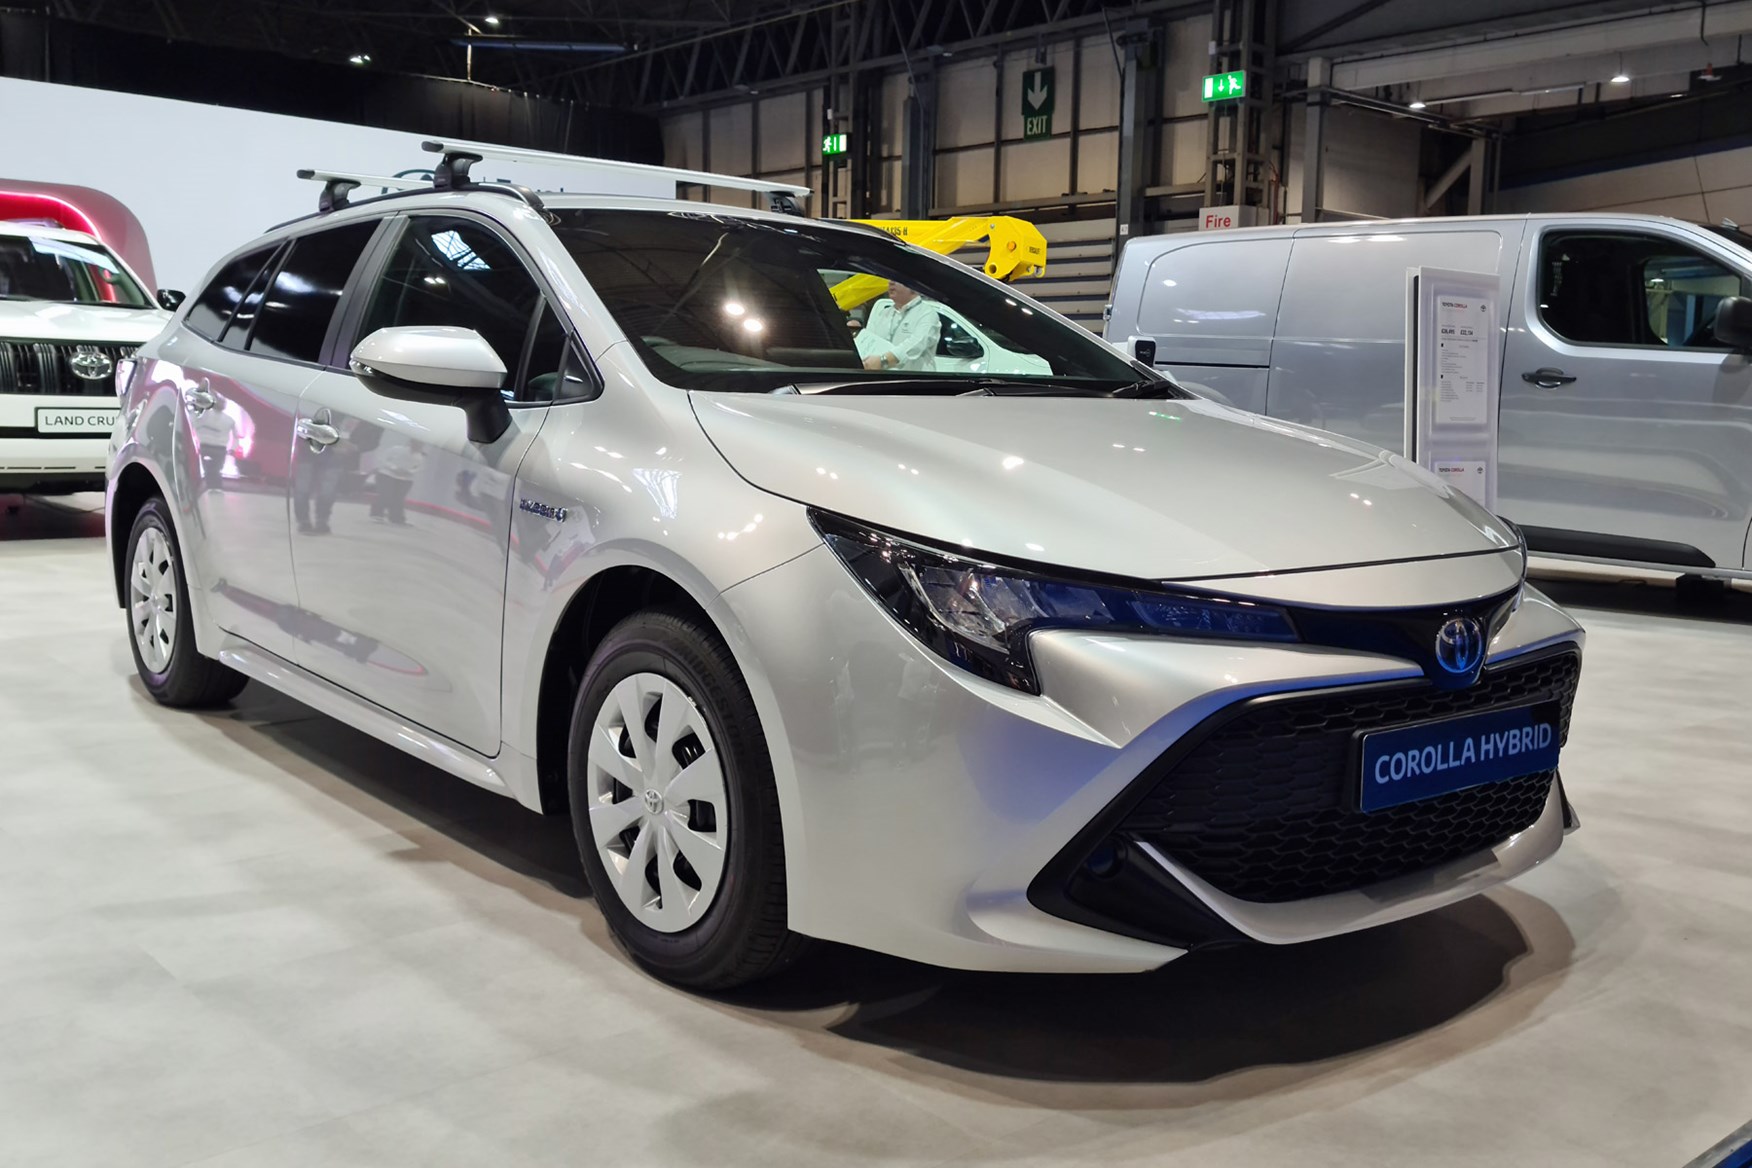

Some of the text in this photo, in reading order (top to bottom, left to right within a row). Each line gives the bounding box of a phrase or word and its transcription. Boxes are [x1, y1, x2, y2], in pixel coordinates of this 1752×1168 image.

[1026, 115, 1048, 135] EXIT
[1205, 214, 1231, 229] Fire
[45, 415, 116, 426] LAND CRU
[1374, 722, 1552, 785] COROLLA HYBRID
